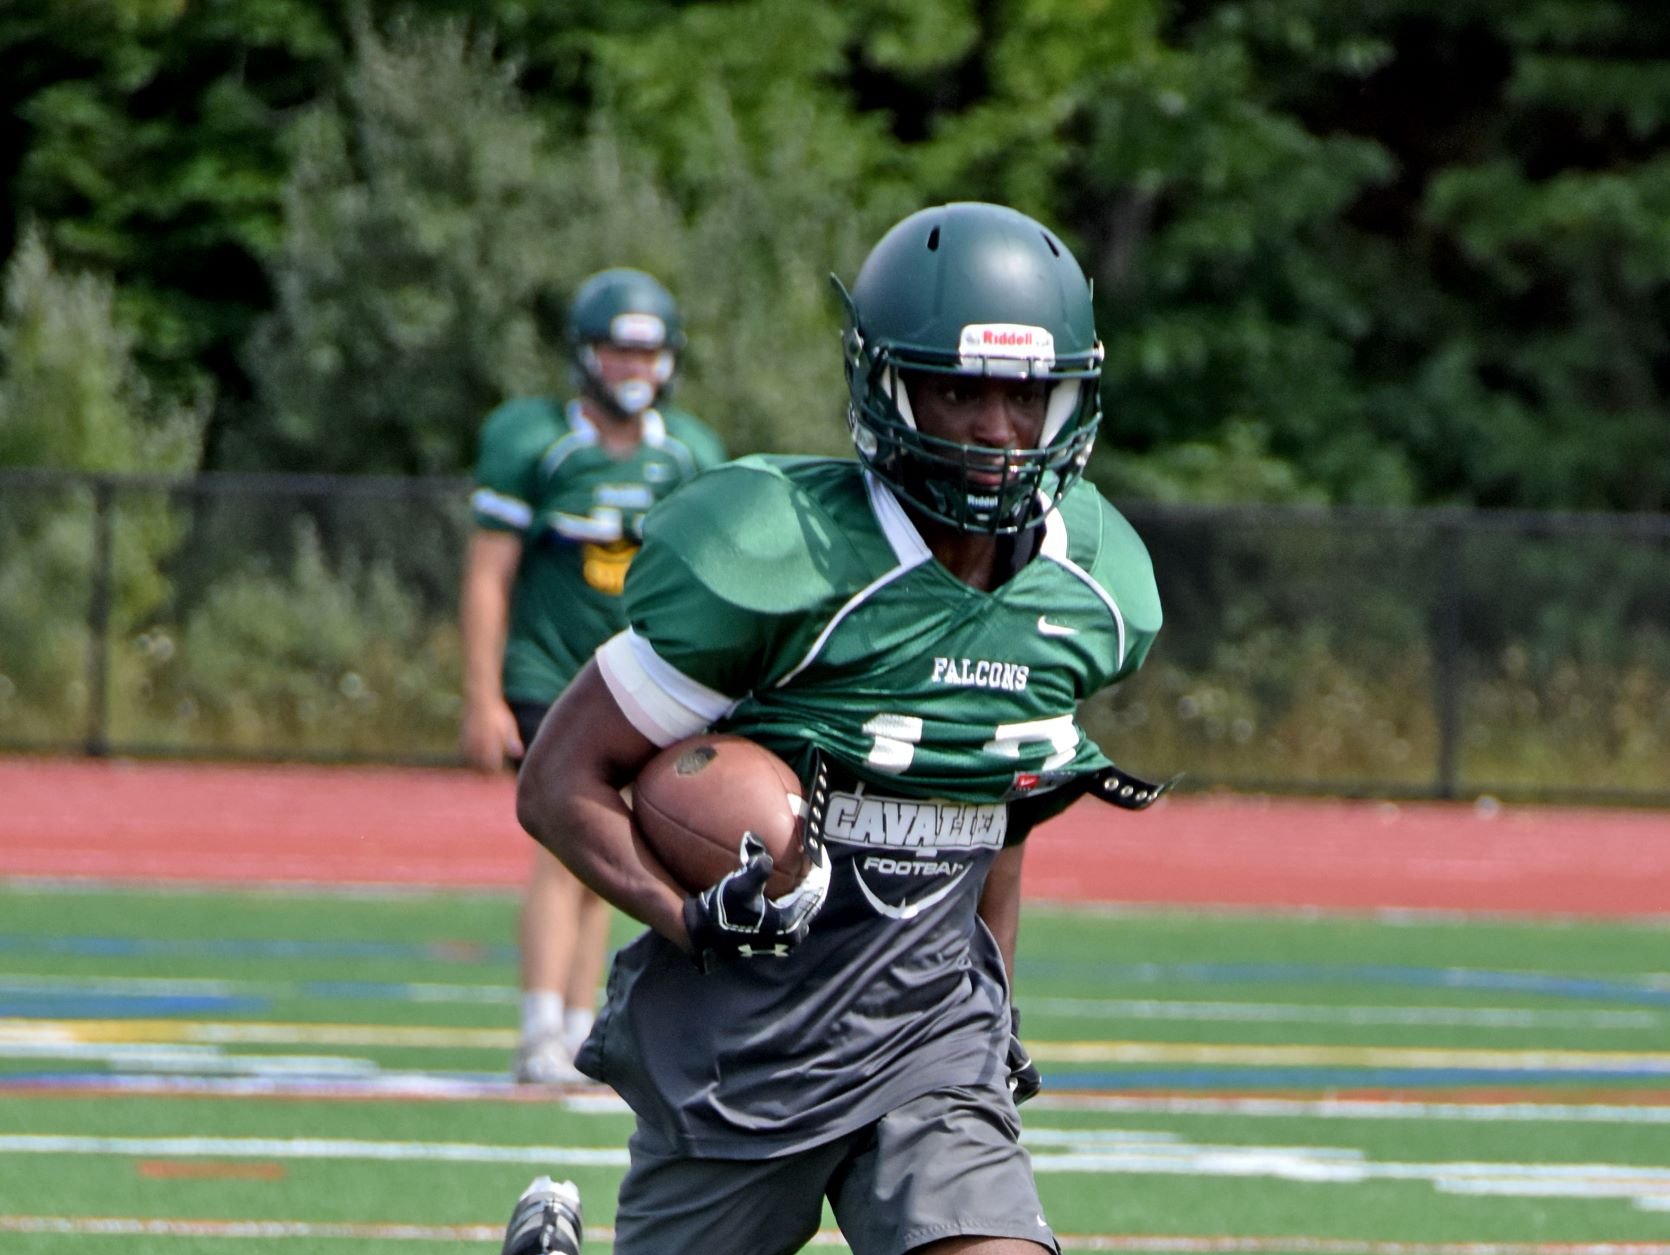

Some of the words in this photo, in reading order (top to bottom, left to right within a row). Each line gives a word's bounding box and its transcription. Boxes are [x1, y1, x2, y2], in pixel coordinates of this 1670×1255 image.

[983, 330, 1033, 346] Riddell
[967, 494, 999, 507] Riddel
[931, 656, 1030, 691] FALCONS
